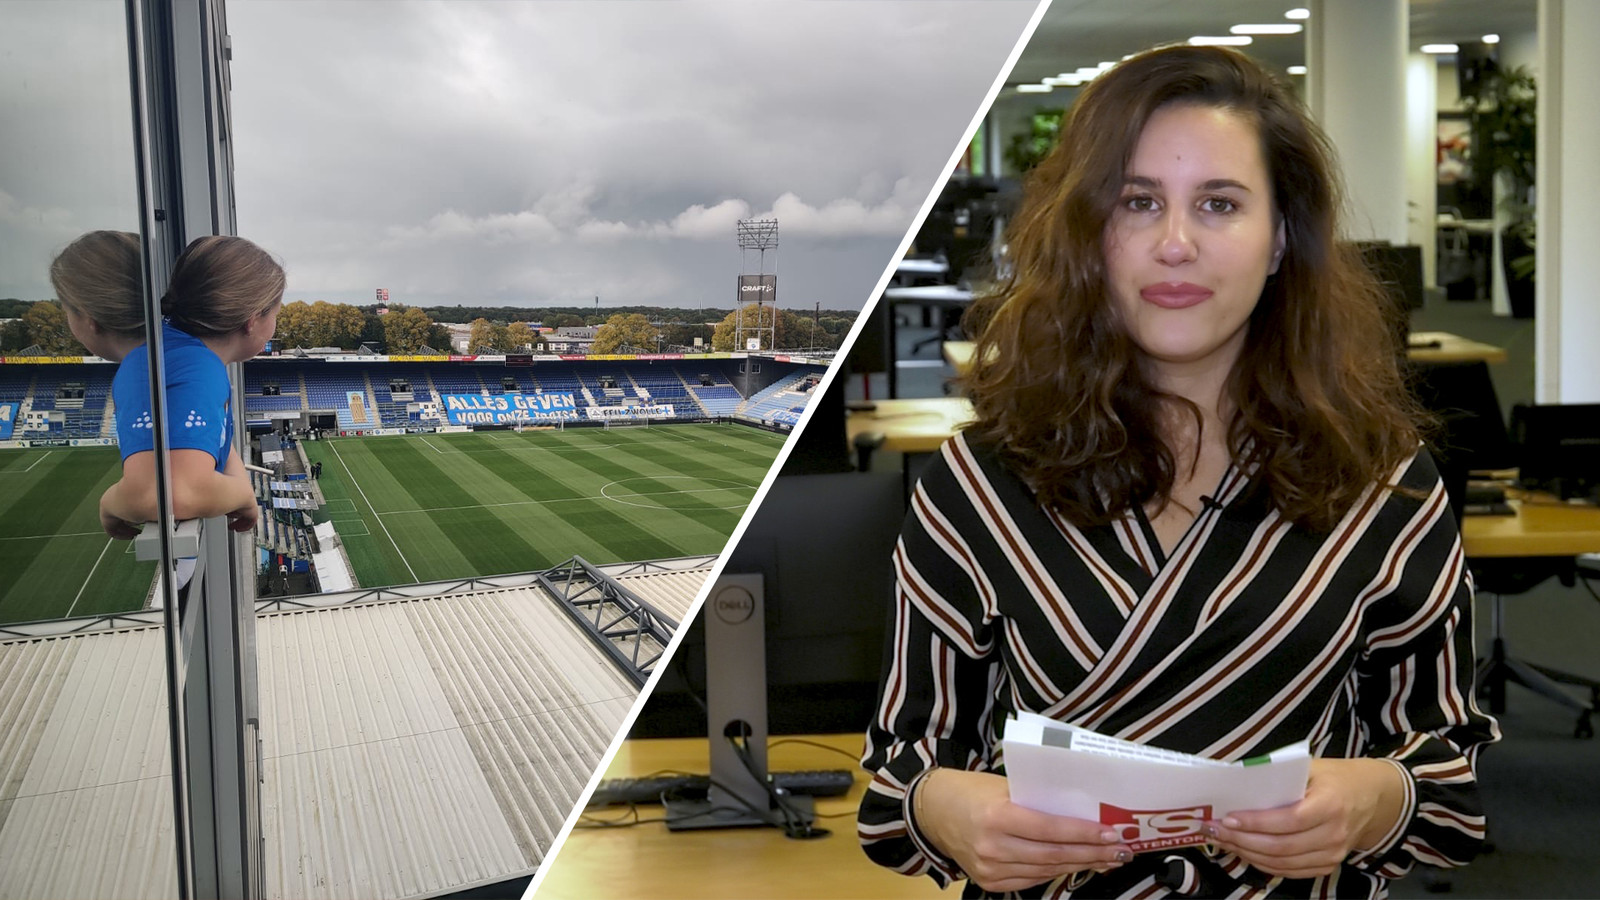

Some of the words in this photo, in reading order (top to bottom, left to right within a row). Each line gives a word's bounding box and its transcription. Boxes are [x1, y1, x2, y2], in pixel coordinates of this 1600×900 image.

[447, 396, 509, 411] ALLES
[513, 393, 576, 410] GEVEN
[456, 411, 494, 424] VOOR
[497, 409, 531, 421] ONZE
[719, 601, 750, 611] DELL
